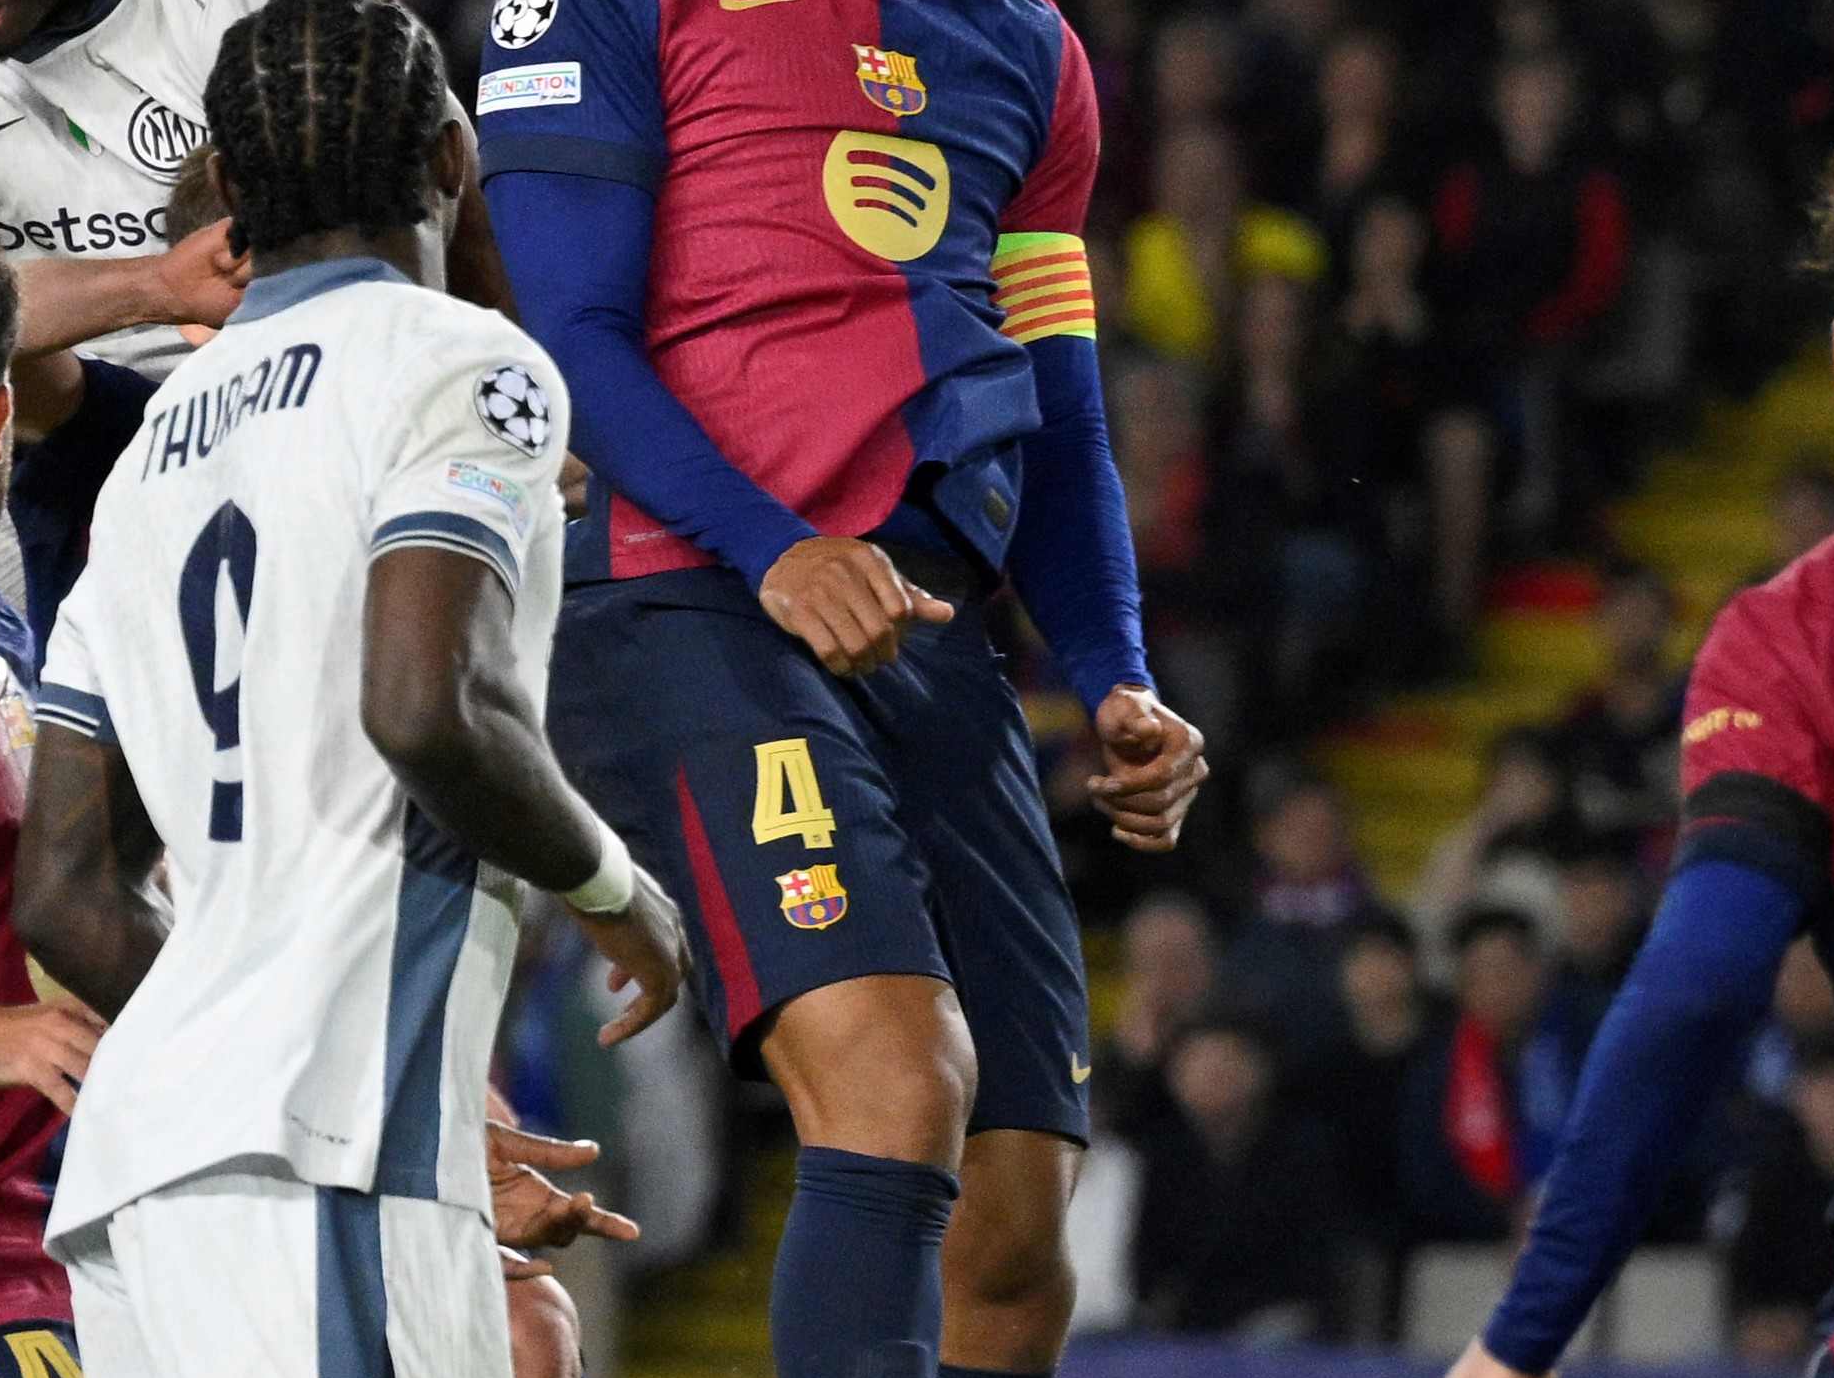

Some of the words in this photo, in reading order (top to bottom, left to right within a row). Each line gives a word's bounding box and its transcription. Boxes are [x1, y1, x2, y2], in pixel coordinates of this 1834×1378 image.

[141, 343, 322, 482] THURAM
[178, 499, 257, 842] 9
[752, 738, 836, 848] 4
